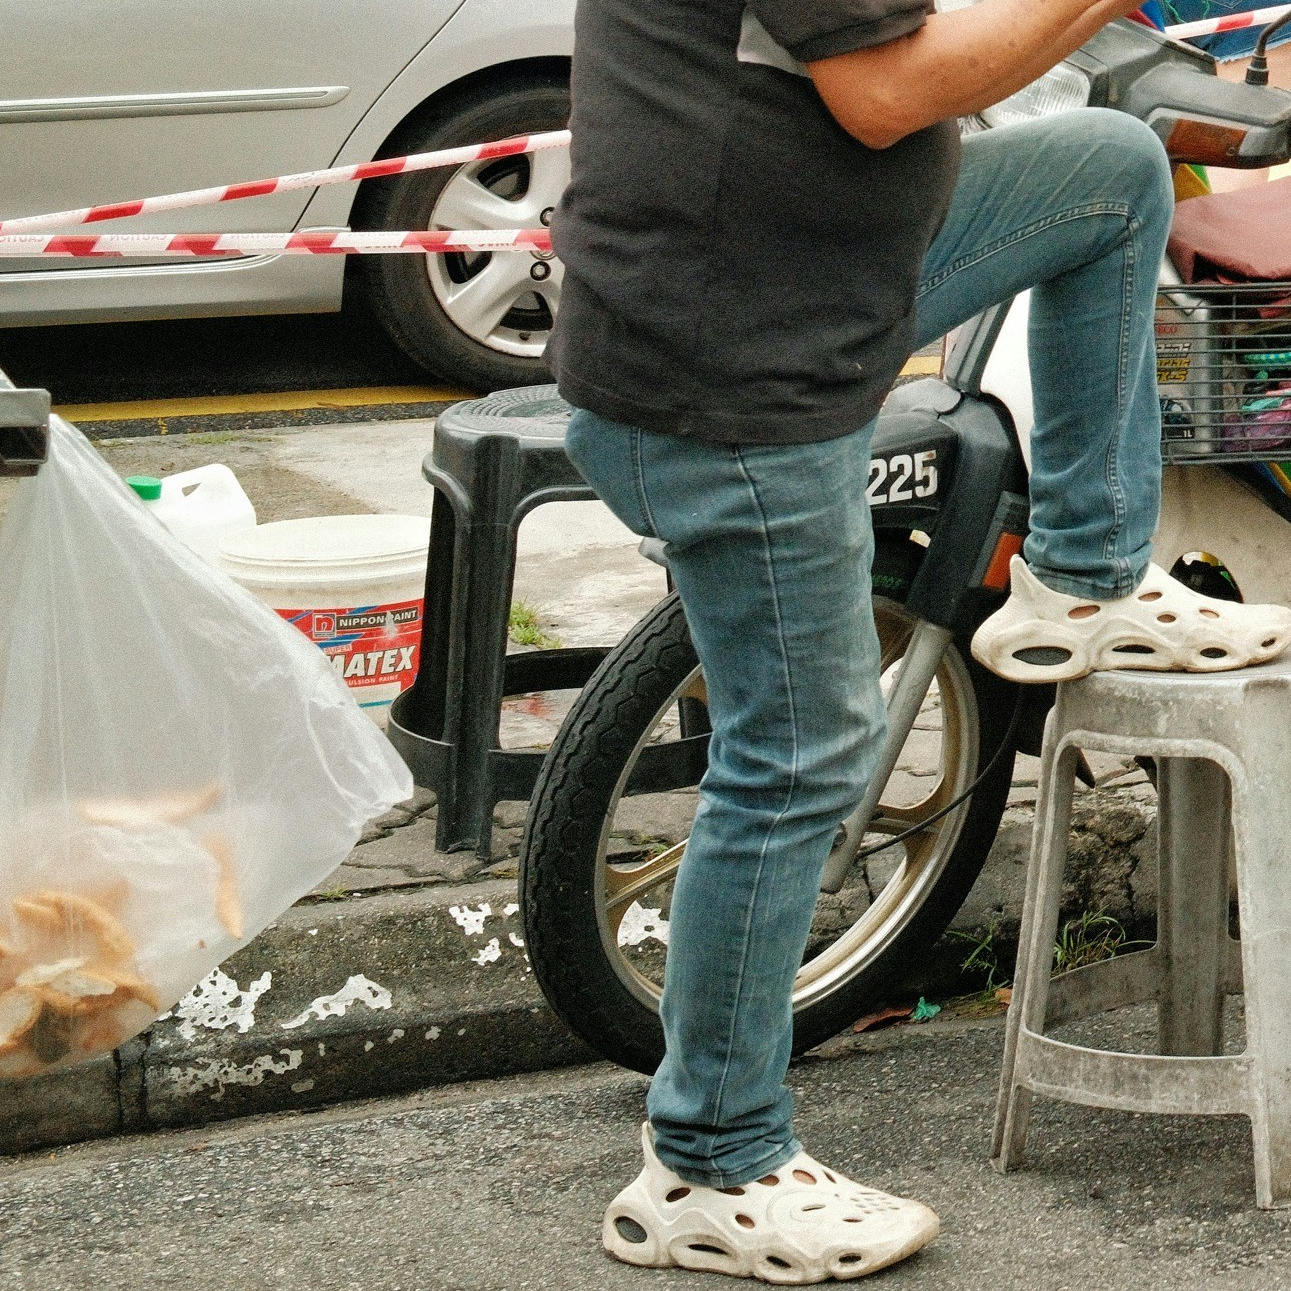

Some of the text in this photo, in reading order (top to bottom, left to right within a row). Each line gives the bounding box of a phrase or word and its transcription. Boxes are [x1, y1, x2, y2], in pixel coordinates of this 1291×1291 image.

[339, 615, 385, 627] NIPPON
[346, 674, 398, 686] ULSION PAINT
